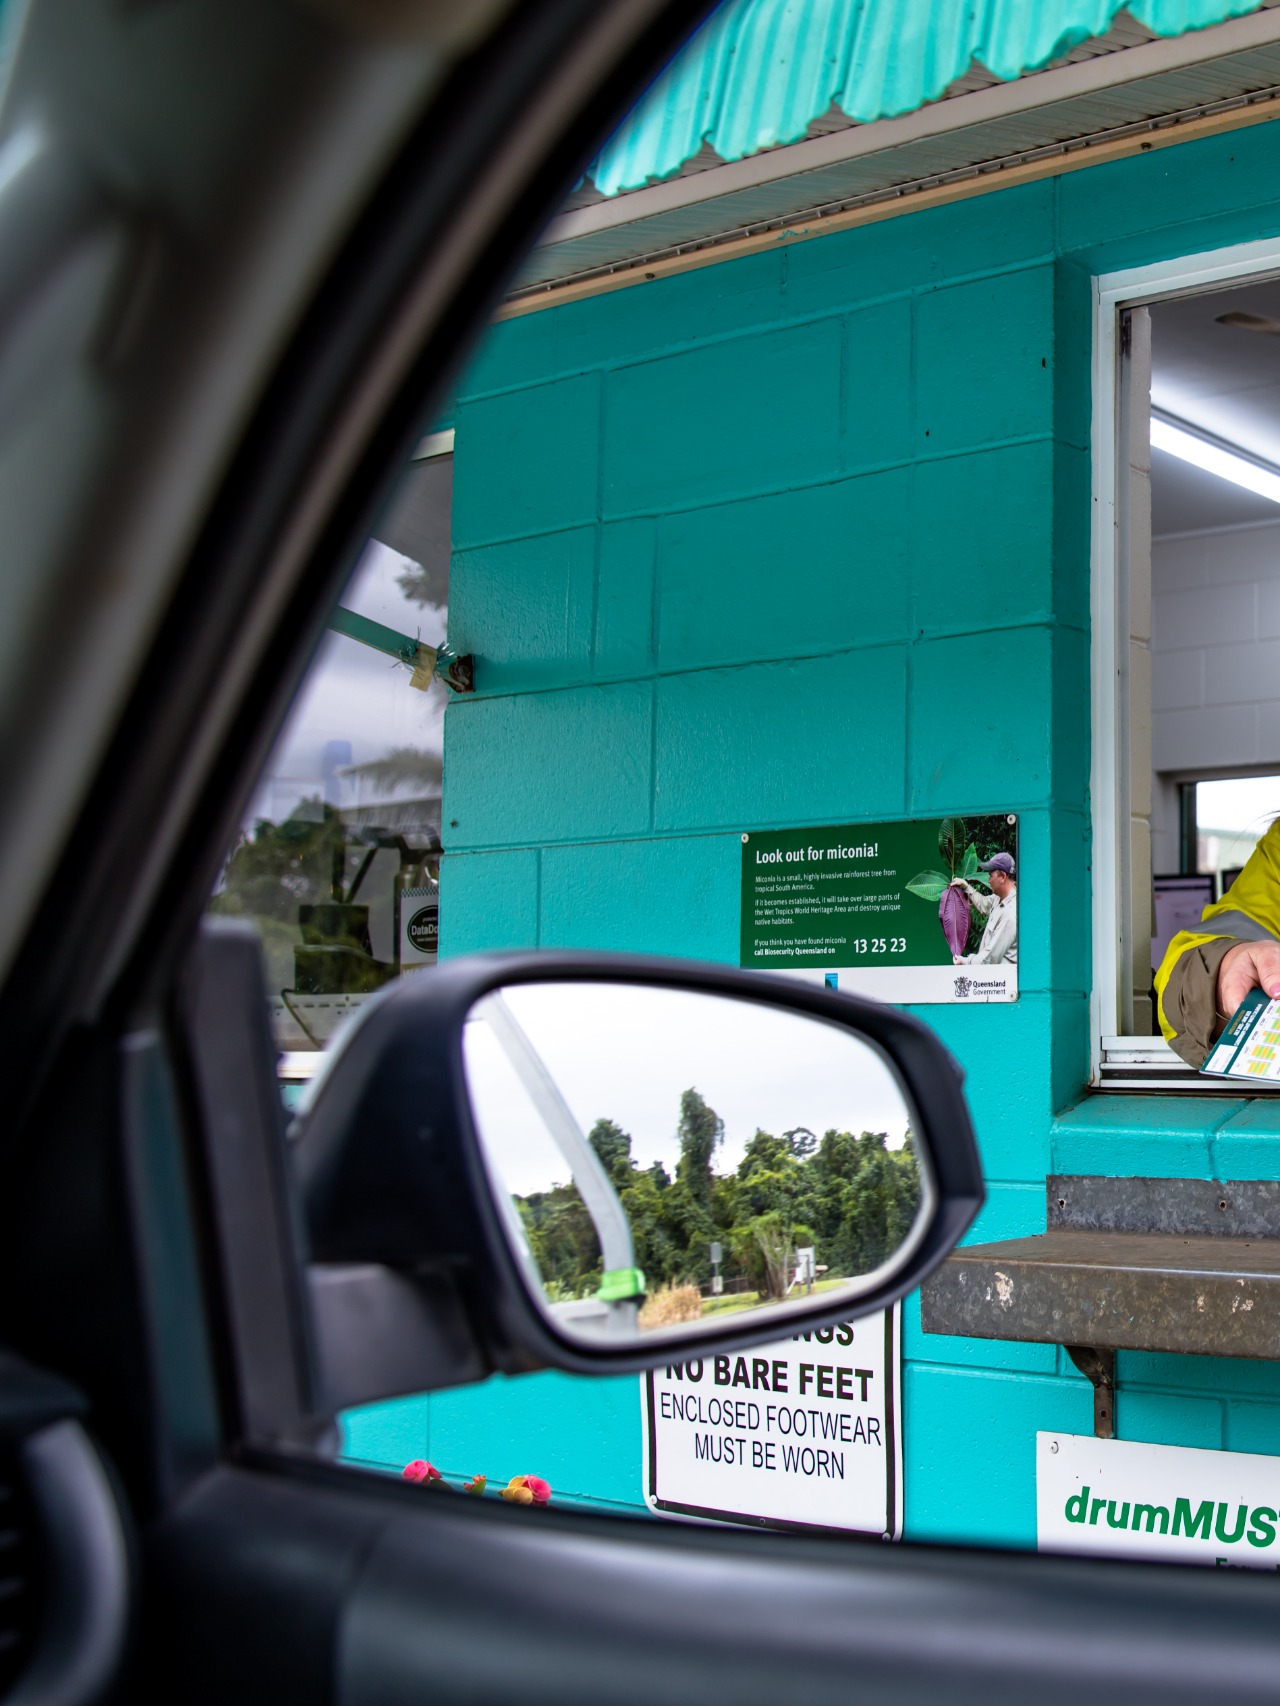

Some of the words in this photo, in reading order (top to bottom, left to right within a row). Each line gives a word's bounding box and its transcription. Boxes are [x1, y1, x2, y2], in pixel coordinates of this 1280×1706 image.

[755, 849, 783, 864] Look
[785, 848, 805, 862] out
[807, 846, 824, 861] for
[826, 843, 879, 859] miconia!
[786, 874, 803, 882] small,
[803, 873, 820, 882] highly
[820, 872, 843, 880] invasive
[843, 870, 870, 879] rainforest
[755, 885, 775, 893] tropical
[775, 884, 791, 892] South
[791, 883, 815, 891] America.
[764, 898, 788, 906] becomes
[788, 897, 821, 905] established,
[826, 895, 837, 903] will
[837, 895, 850, 903] take
[863, 894, 877, 903] large
[764, 908, 774, 916] Wet
[775, 908, 794, 916] Tropics
[810, 906, 834, 915] Heritage
[859, 904, 880, 912] destroy
[881, 903, 901, 911] unique
[769, 938, 783, 946] think
[783, 939, 794, 947] you
[794, 937, 807, 945] have
[807, 937, 824, 945] found
[824, 936, 847, 944] miconia
[853, 939, 867, 953] 13
[871, 938, 886, 953] 25
[890, 937, 906, 952] 23
[764, 948, 794, 956] Biosecurity
[795, 947, 827, 955] Queensland
[973, 980, 1006, 988] Queensland
[665, 1357, 704, 1382] NO
[713, 1355, 789, 1393] BARE
[799, 1362, 874, 1402] FEET
[660, 1391, 760, 1430] ENCLOSED
[766, 1405, 882, 1447] FOOTWEAR
[695, 1432, 747, 1466] MUST
[752, 1440, 776, 1471] BE
[782, 1444, 845, 1480] WORN
